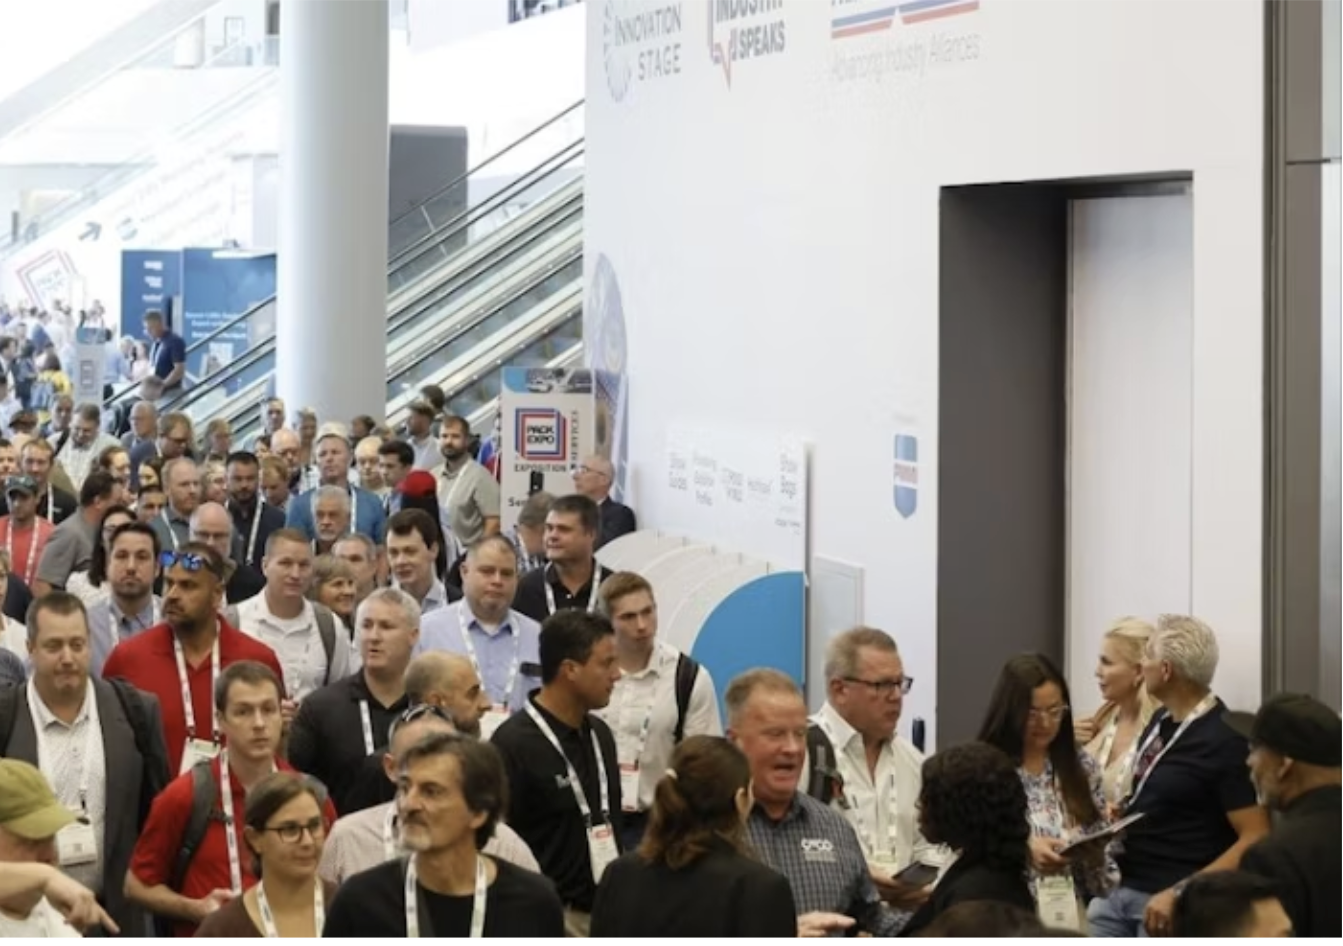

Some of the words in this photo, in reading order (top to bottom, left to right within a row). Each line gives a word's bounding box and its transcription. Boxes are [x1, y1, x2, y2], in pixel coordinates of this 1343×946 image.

[739, 19, 785, 60] SPEAKS
[638, 43, 682, 80] STAGE
[526, 424, 555, 434] PACK
[526, 434, 556, 445] EXPO
[513, 462, 567, 473] EXPOSITION
